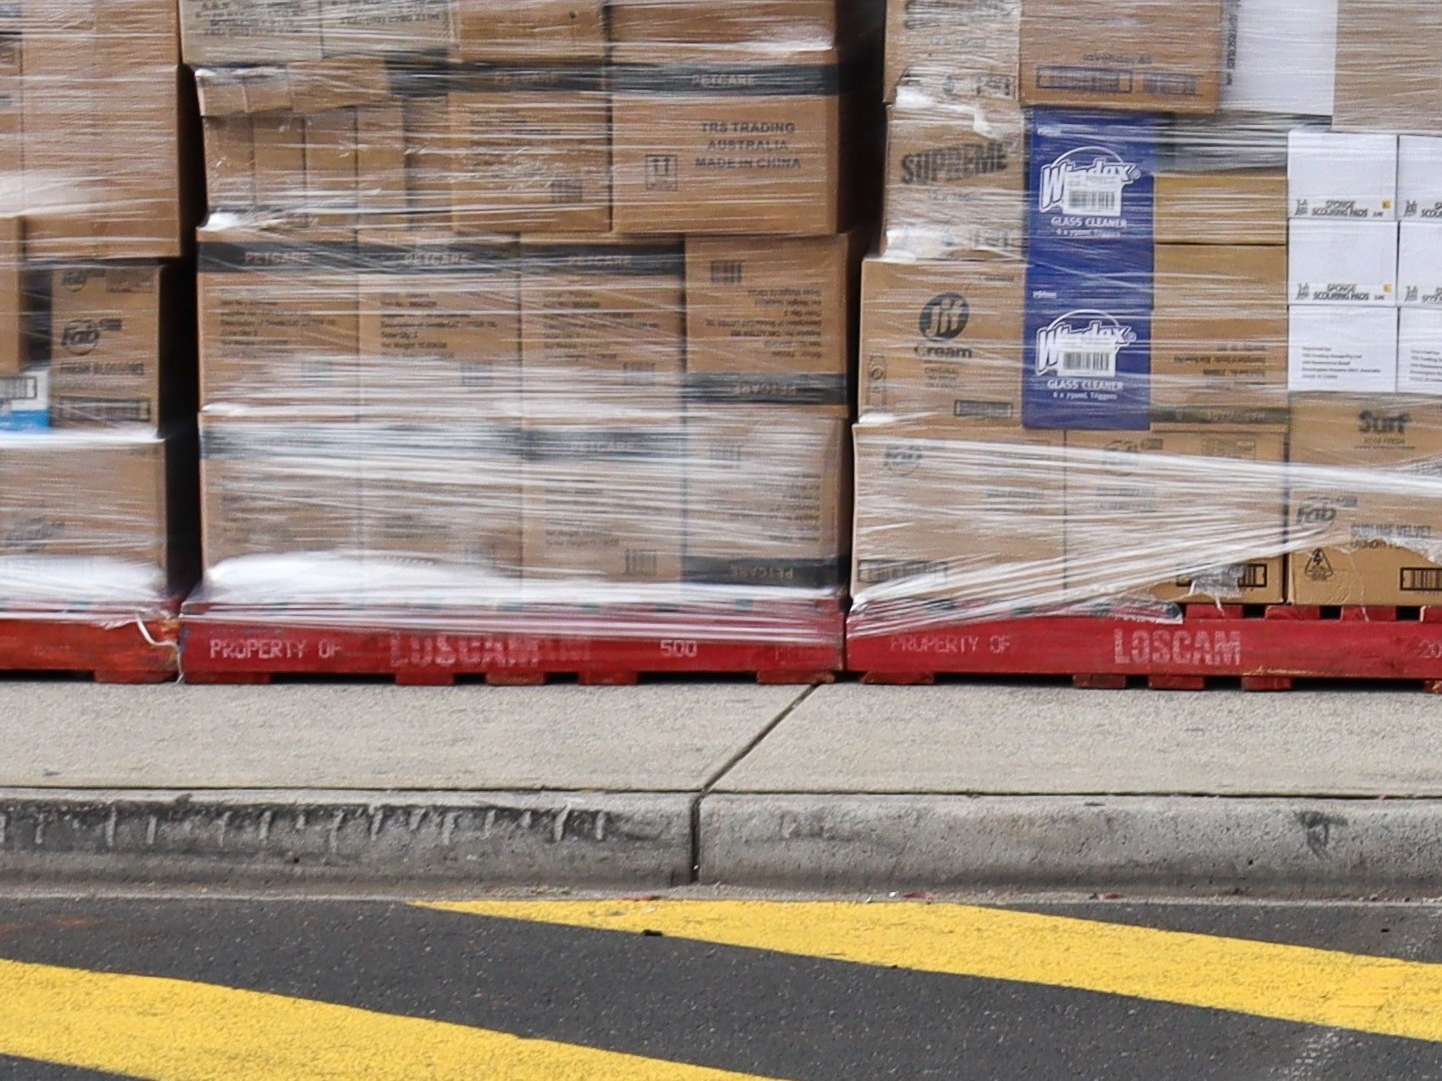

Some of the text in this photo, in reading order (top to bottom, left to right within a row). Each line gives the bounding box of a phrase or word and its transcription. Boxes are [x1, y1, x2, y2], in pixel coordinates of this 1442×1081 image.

[732, 122, 796, 134] TRADING
[708, 140, 788, 151] AUSTRALIA
[695, 158, 735, 169] MADE
[757, 158, 801, 170] CHINA
[1051, 217, 1127, 228] GLASS CLEANER
[914, 343, 972, 359] Cream
[1048, 380, 1124, 390] GLASS CLEANER
[1358, 410, 1410, 434] Surf
[209, 638, 698, 658] PROPERTY 500
[890, 636, 978, 653] PROPERTY
[990, 638, 1011, 654] OF
[1113, 630, 1242, 666] LOSCAM
